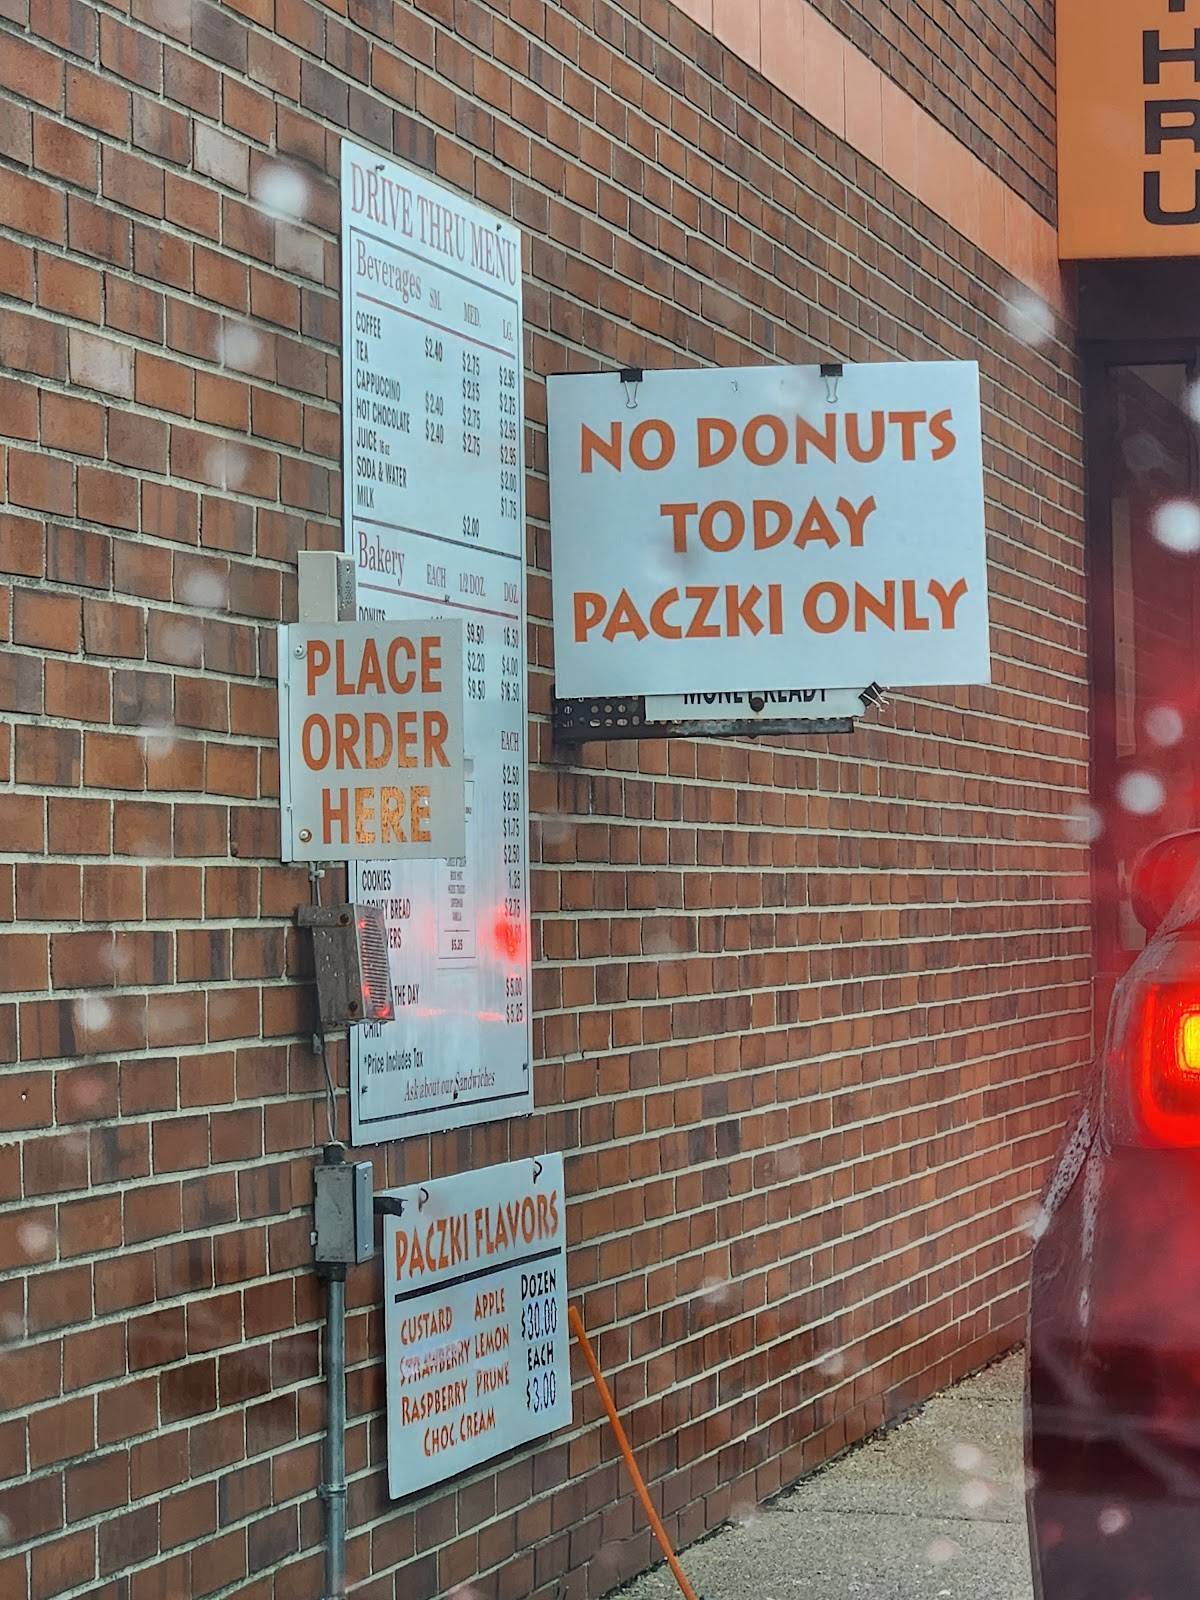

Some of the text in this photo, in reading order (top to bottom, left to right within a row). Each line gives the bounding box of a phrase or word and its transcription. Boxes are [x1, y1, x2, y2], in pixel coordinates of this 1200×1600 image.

[1143, 0, 1200, 225] HRU
[351, 161, 517, 286] DRIVE THRU MENU
[356, 238, 422, 304] Beverages
[356, 310, 382, 339] COFFEE
[424, 336, 443, 362] $2.40
[462, 351, 480, 376] $2.75
[356, 340, 369, 363] TEA
[356, 369, 401, 402] CAPPUCCINO
[425, 391, 444, 417] $2.40
[462, 405, 481, 430] $2.75
[356, 398, 370, 420] HOT
[372, 402, 410, 434] CHOCOLATE
[425, 419, 444, 445] $2.40
[463, 431, 480, 457] $2.75
[356, 426, 377, 452] JUICE
[500, 471, 517, 493] $2.00
[580, 408, 957, 474] NO DONUTS
[356, 456, 517, 520] SODA & WATER $1.75
[356, 484, 480, 539] MILK $2.00
[659, 494, 878, 553] TODAY
[358, 531, 405, 587] Bakery
[426, 564, 447, 589] EACH
[467, 621, 485, 645] $9.50
[573, 577, 969, 643] PACZKI ONLY
[306, 636, 443, 696] PLACE
[467, 650, 518, 677] $2.20 $4.00
[301, 710, 452, 771] ORDER
[501, 730, 519, 752] EACH
[502, 763, 519, 785] $2.50
[321, 785, 432, 845] HERE
[503, 817, 520, 838] $1.75
[362, 869, 392, 891] COOKIES
[390, 898, 411, 920] BREAD
[394, 977, 522, 1006] THE DAY $5.00
[506, 1003, 523, 1024] $5.25
[386, 1050, 412, 1073] Includes
[413, 1048, 424, 1069] Tax
[404, 1067, 496, 1101] Ask about our Sandwiches
[395, 1189, 559, 1281] PACZKI FLAVORS
[521, 1268, 557, 1300] DOZEN
[400, 1287, 557, 1346] CUSTARD APPLE $30.00
[474, 1323, 510, 1360] LEMON
[527, 1341, 554, 1371] EACH
[401, 1361, 556, 1426] RASPBERRY PRUNE $3.00
[459, 1407, 496, 1442] CREAM
